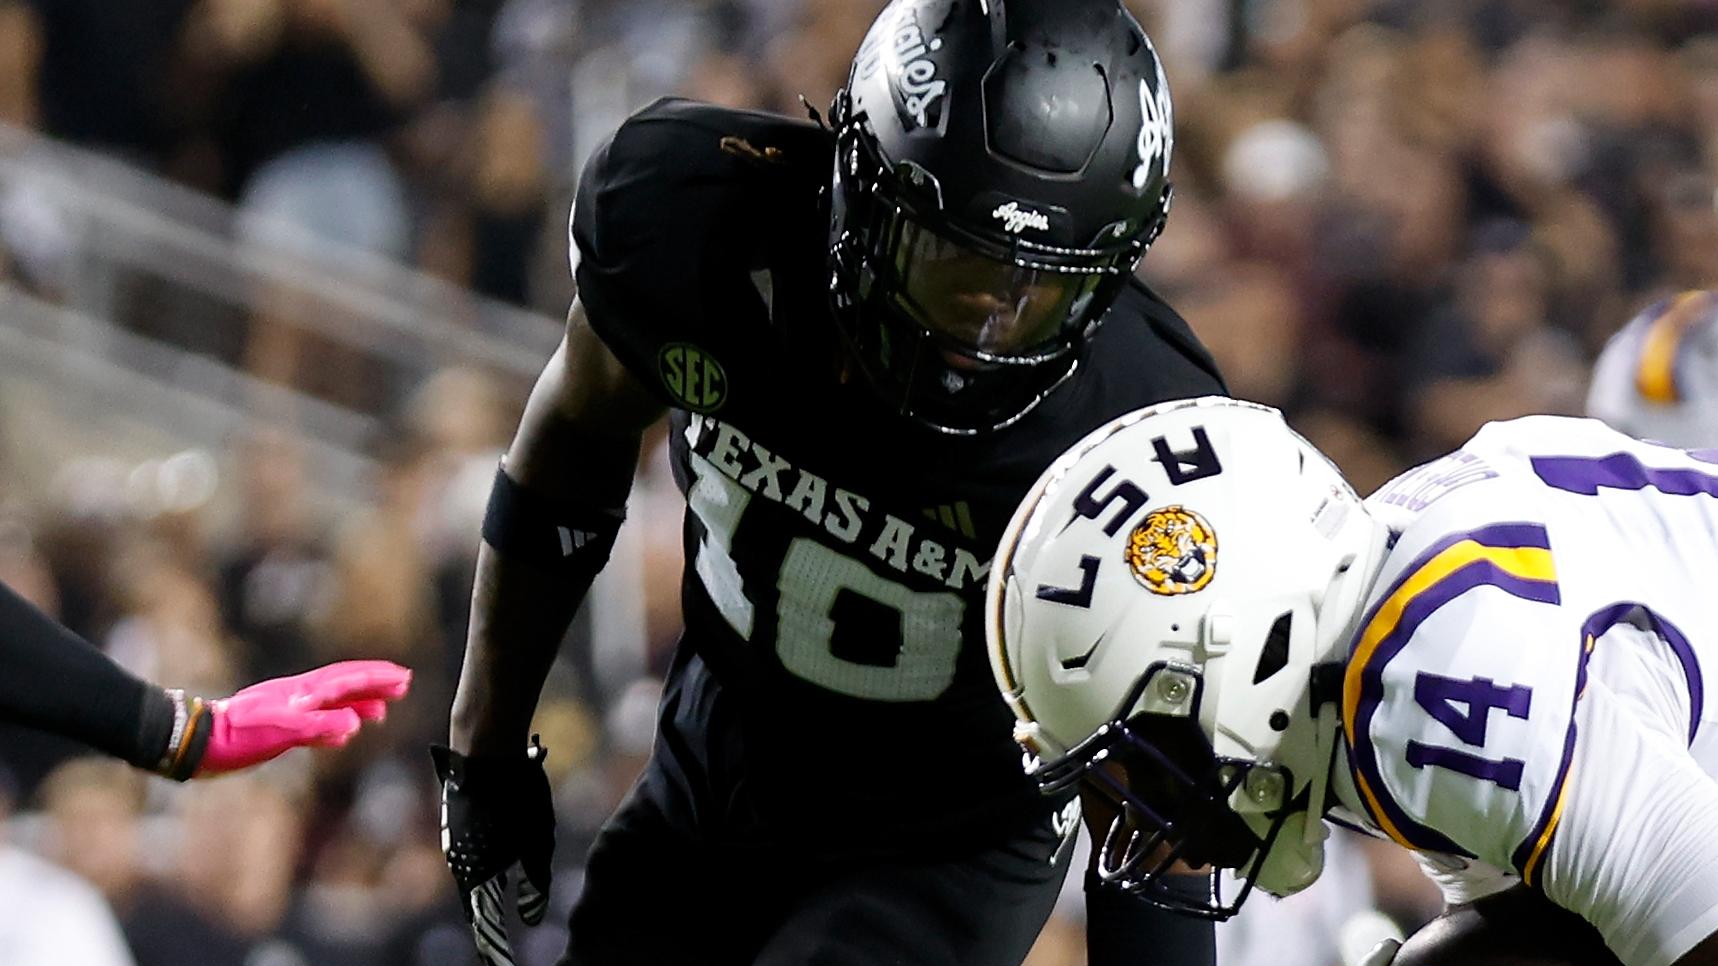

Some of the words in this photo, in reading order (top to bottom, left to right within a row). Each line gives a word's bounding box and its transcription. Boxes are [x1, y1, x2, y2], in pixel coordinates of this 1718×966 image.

[993, 202, 1049, 234] Aggies
[664, 346, 721, 407] SEC
[685, 411, 870, 544] TEXAS
[688, 450, 967, 703] 10
[1405, 670, 1534, 792] 14
